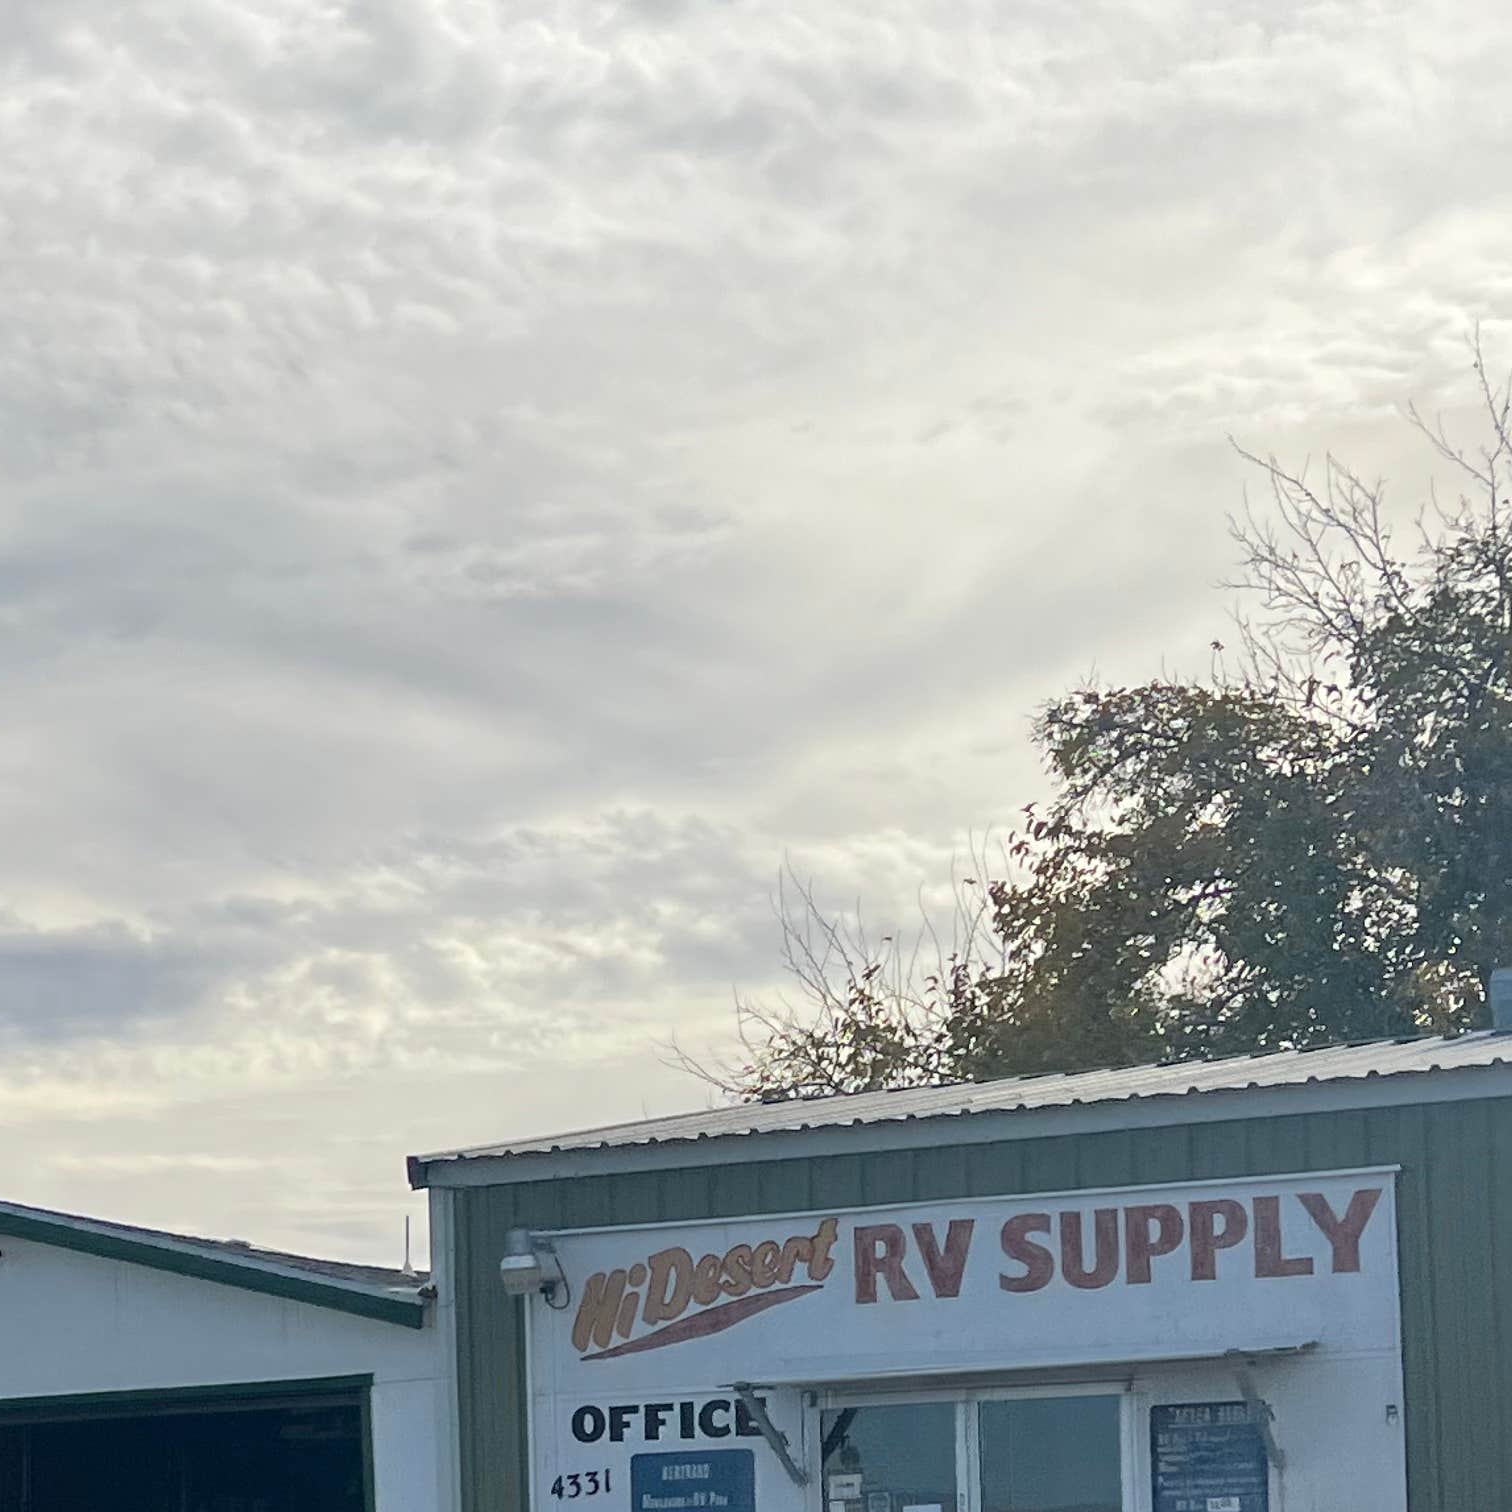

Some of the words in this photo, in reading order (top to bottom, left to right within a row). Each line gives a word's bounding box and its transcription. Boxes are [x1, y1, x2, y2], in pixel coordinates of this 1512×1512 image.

[854, 1218, 976, 1304] RV
[999, 1188, 1383, 1293] SUPPLY
[571, 1397, 768, 1443] OFFICE
[551, 1468, 611, 1500] 4331
